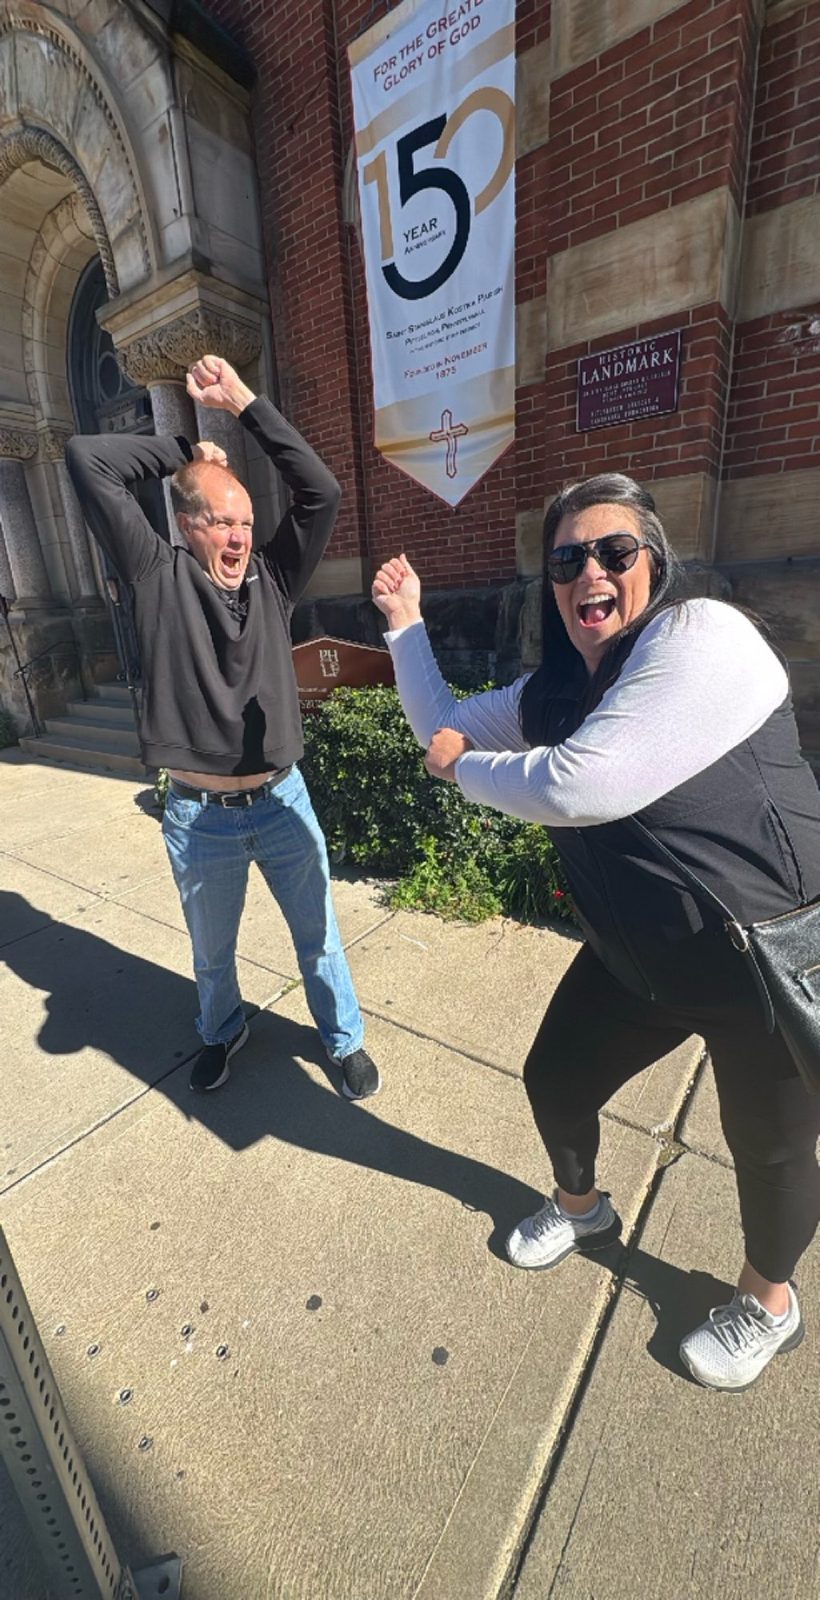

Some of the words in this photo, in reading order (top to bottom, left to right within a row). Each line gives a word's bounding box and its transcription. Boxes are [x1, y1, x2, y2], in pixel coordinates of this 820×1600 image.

[373, 56, 397, 82] FOR
[399, 33, 424, 59] THE
[383, 52, 424, 91] GLORY
[427, 40, 446, 59] OF
[449, 15, 481, 46] GOD
[363, 86, 516, 300] 150
[403, 217, 438, 243] YEAR
[582, 348, 674, 386] LANDMARK
[599, 341, 656, 365] HISTORIC
